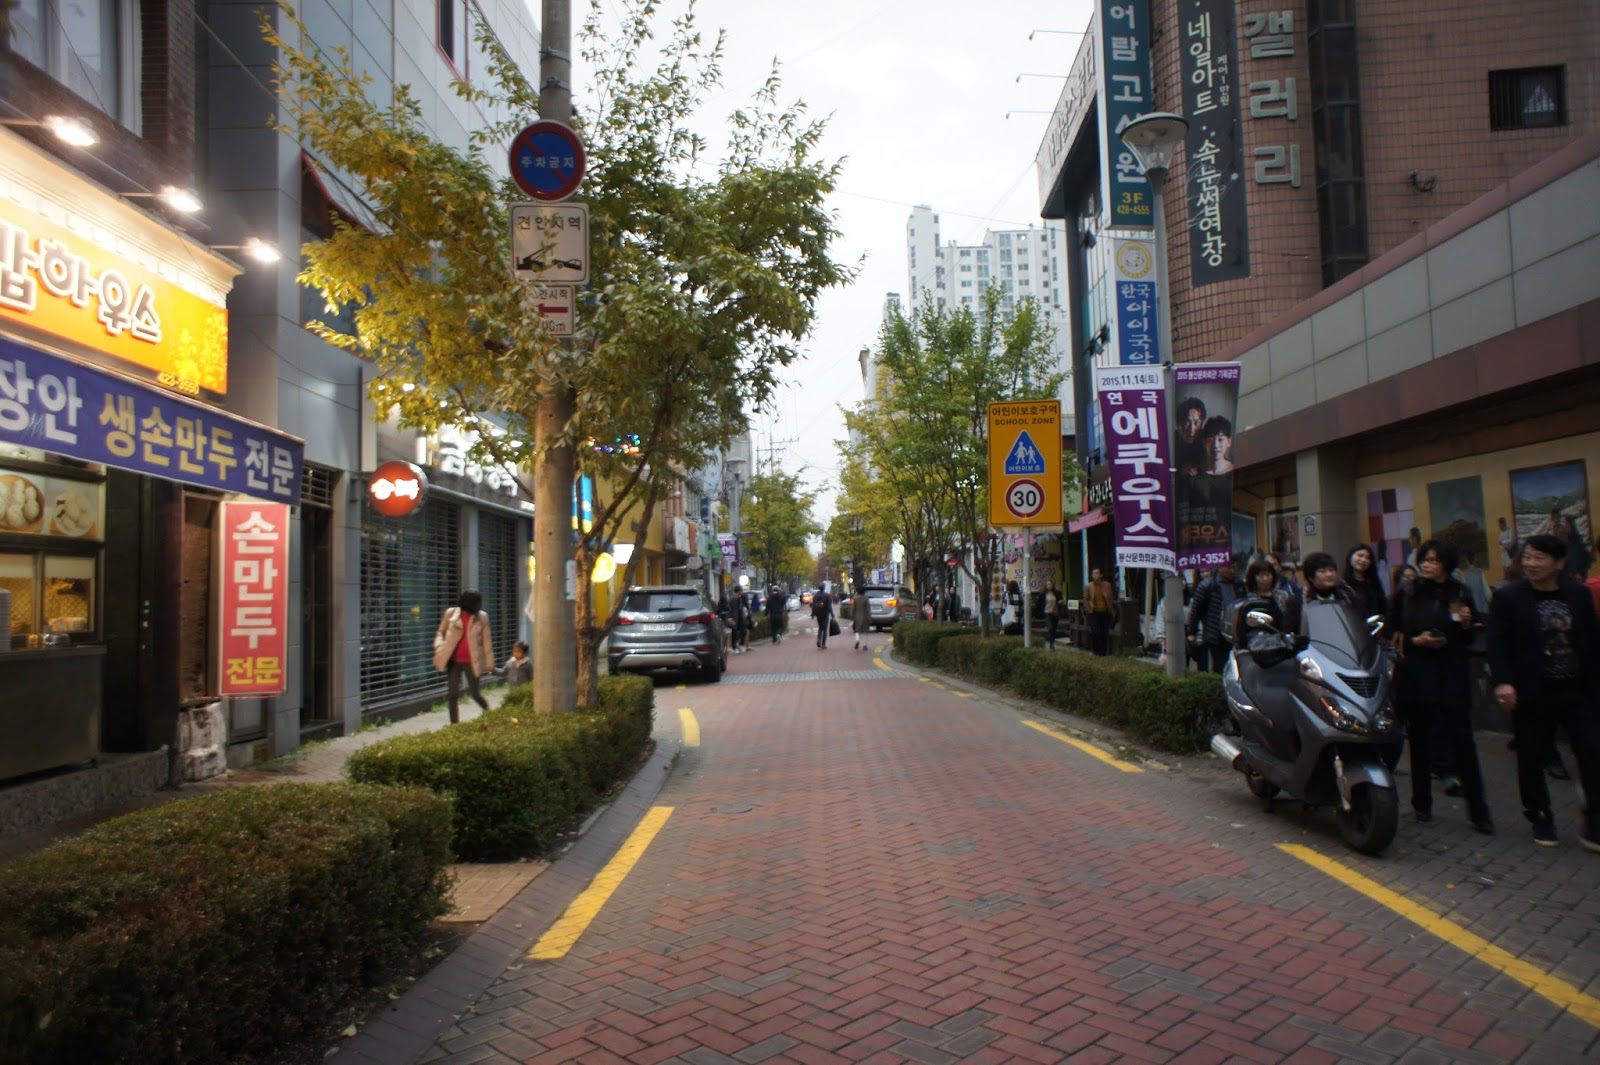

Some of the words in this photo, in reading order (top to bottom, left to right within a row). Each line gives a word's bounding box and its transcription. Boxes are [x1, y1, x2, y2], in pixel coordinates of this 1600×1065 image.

[1188, 12, 1217, 115] 네일아트
[1244, 10, 1301, 187] 갤러리
[521, 156, 574, 169] 주차금지
[1122, 192, 1143, 204] 3F
[1196, 139, 1226, 266] 속눈썹연장
[518, 215, 581, 231] 견인지역
[533, 288, 568, 300] 간시작
[1121, 283, 1151, 299] 한국
[992, 404, 1058, 416] 어린이보호구역
[99, 393, 238, 482] 생손만두
[245, 437, 295, 496] 전문
[1008, 464, 1040, 472] 어린이보호
[1111, 407, 1168, 543] 에쿠우스
[1013, 490, 1037, 507] 30
[1118, 553, 1157, 564] 봉산문화회관
[230, 511, 279, 649] 손만두
[226, 656, 281, 685] 전문
